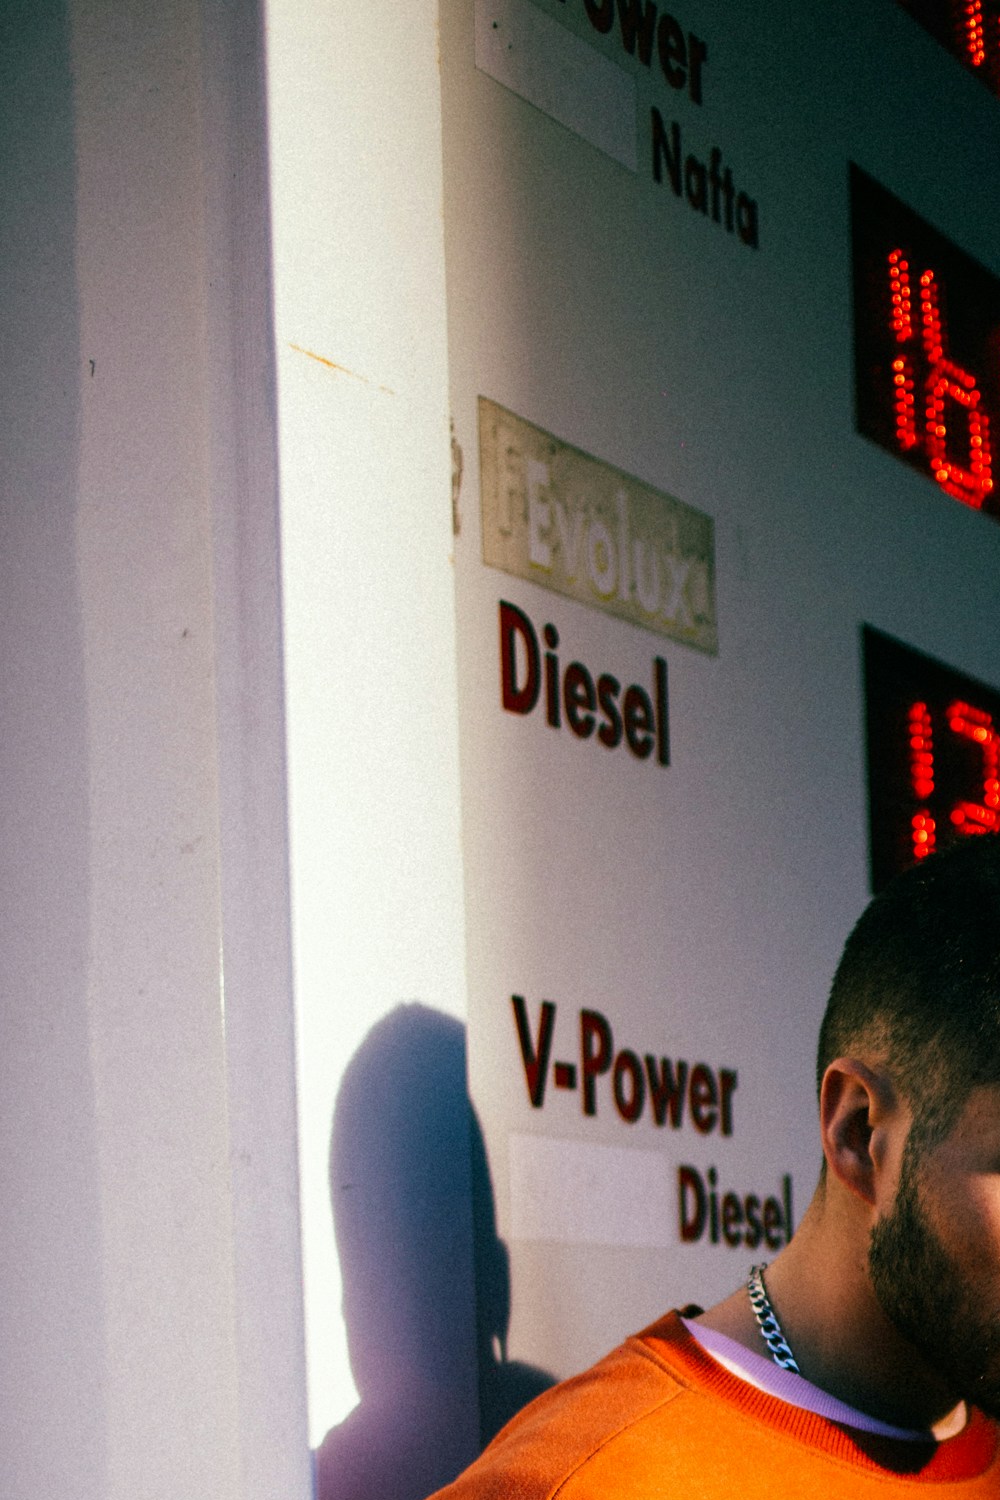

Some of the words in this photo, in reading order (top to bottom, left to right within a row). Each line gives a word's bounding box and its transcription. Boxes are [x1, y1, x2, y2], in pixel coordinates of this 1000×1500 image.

[651, 105, 759, 250] Nafta
[498, 598, 671, 768] Diesel
[510, 994, 738, 1138] V-Power
[677, 1164, 793, 1250] Diesel
